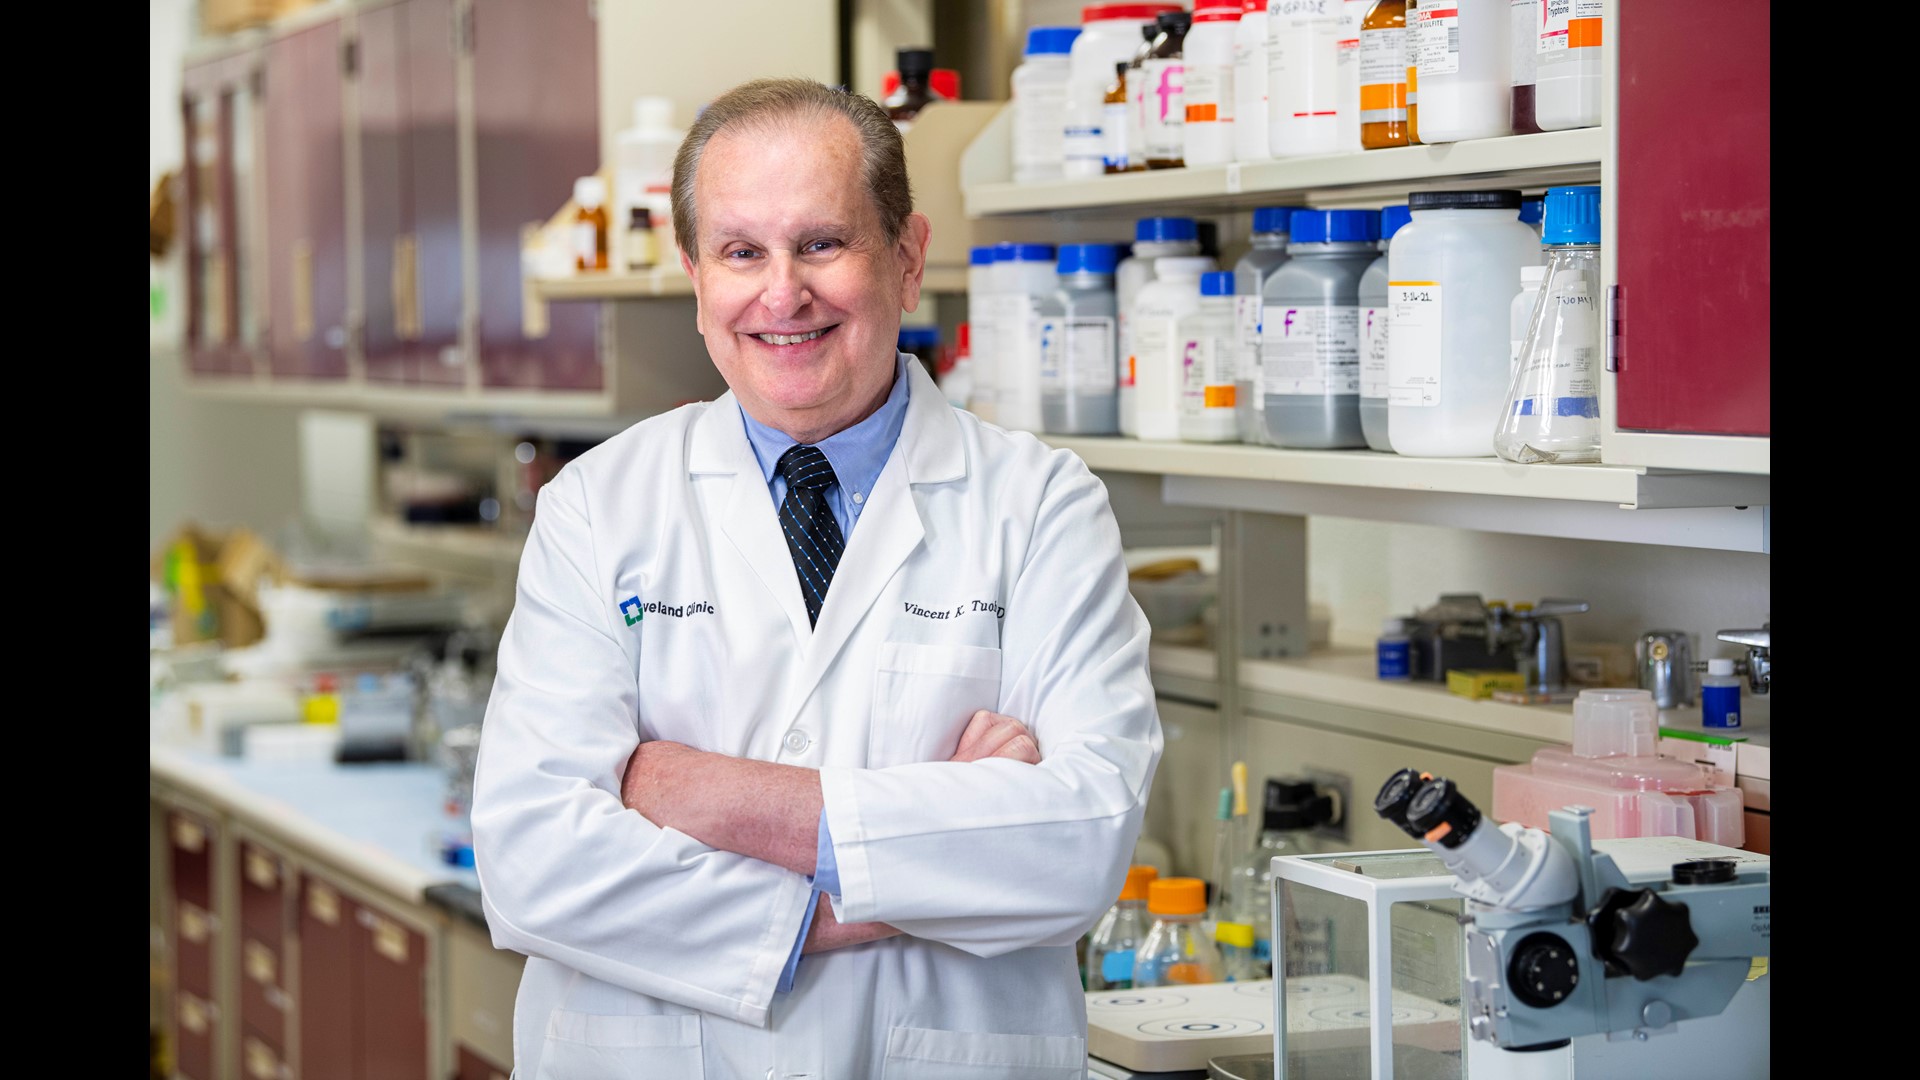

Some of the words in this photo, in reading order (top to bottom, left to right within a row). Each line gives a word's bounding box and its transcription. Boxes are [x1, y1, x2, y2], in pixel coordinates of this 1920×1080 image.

[1547, 6, 1570, 18] Tryptone
[1423, 20, 1444, 28] SULFITE
[643, 601, 683, 618] veland
[686, 601, 715, 617] Clinic
[904, 602, 950, 619] Vincent
